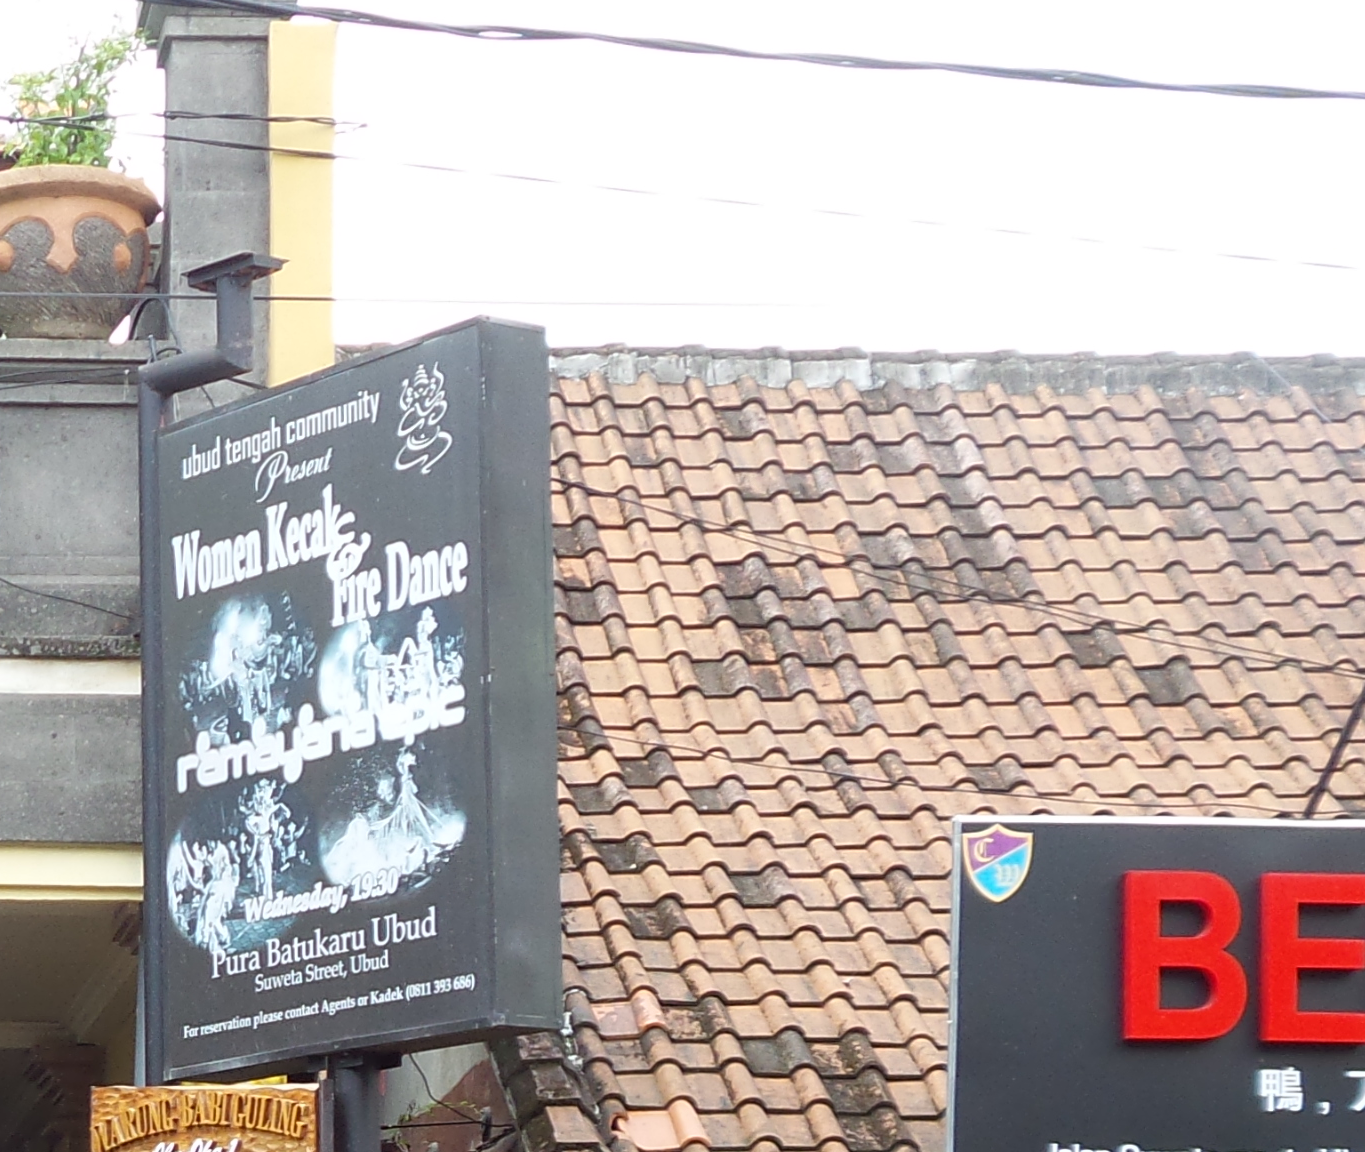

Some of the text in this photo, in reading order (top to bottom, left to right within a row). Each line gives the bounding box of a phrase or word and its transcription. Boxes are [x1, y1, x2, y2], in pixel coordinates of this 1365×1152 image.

[183, 390, 380, 480] ubud tengah community
[255, 447, 333, 503] Present
[172, 484, 356, 599] Women Kecak
[331, 541, 469, 628] Fire Dance
[242, 868, 400, 924] Wednesday, 19:30
[211, 907, 438, 979] Pura Batukaru Ubud
[255, 951, 389, 993] Suweta Street, Ubud
[1122, 870, 1365, 1044] BE
[183, 1023, 198, 1039] For
[200, 1013, 252, 1037] reservation
[253, 1007, 283, 1030] please
[284, 1001, 319, 1022] contact
[321, 996, 356, 1017] Agents
[357, 995, 368, 1007] or
[369, 987, 404, 1006] Kadek
[179, 1090, 230, 1128] BABI
[232, 1091, 309, 1139] GULING
